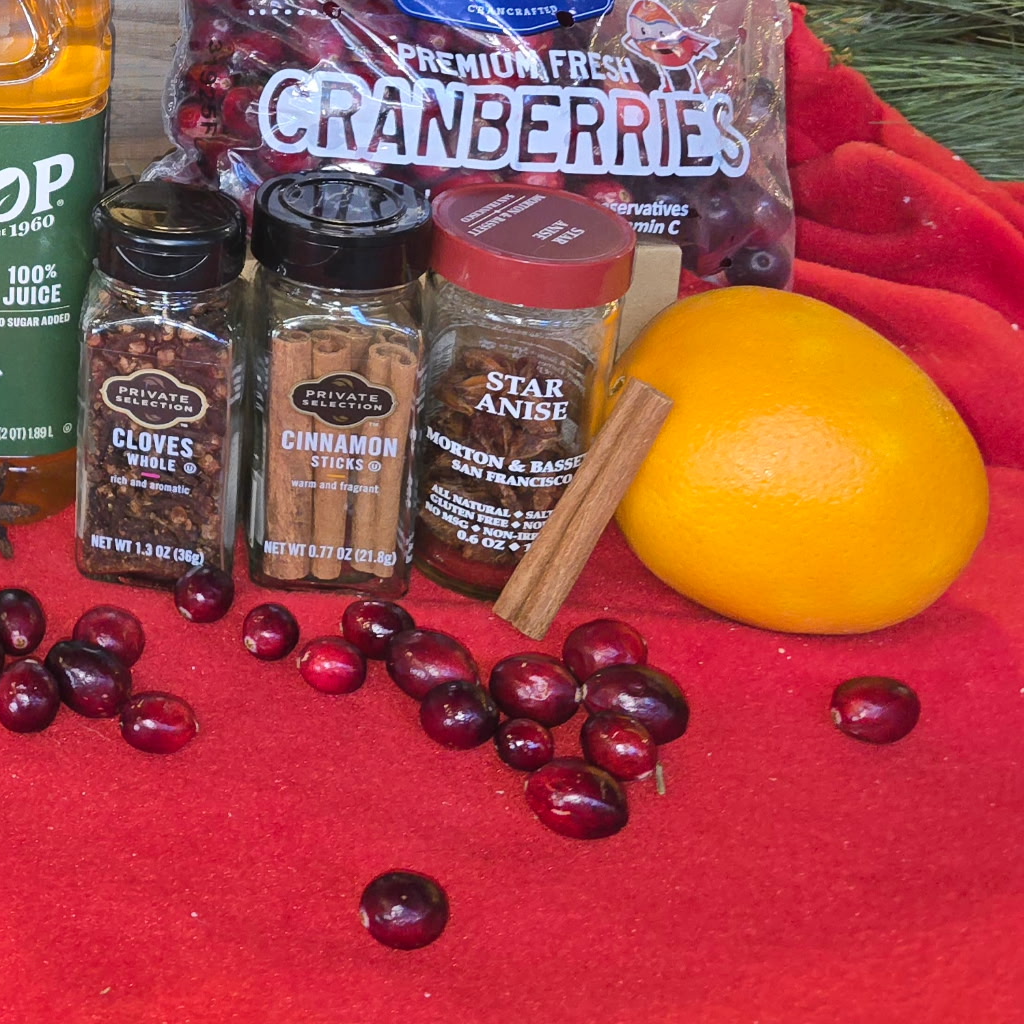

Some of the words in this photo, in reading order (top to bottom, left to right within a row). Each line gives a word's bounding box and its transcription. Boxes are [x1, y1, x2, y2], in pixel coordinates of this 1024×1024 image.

[467, 4, 558, 16] CRANCRAFTED
[397, 42, 538, 79] PREMIUM
[549, 50, 640, 83] FRESH
[262, 70, 748, 175] CRANBERRIES
[602, 200, 689, 216] servatives
[9, 214, 55, 237] 1960
[628, 219, 665, 234] min
[668, 220, 681, 235] C
[8, 264, 57, 284] 100%
[2, 284, 62, 306] JUICE
[7, 316, 39, 328] SUGAR
[41, 313, 70, 326] ADDED
[119, 386, 189, 404] PRIVATE
[305, 389, 379, 402] PRIVATE
[486, 371, 564, 398] STAR
[115, 396, 193, 413] SELECTION
[302, 399, 382, 411] SELECTION
[474, 393, 569, 421] ANISE
[9, 426, 26, 441] QT)
[48, 425, 54, 438] L
[112, 427, 193, 459] CLOVES
[281, 430, 398, 458] CINNAMON
[426, 426, 505, 470] MORTON
[508, 460, 526, 473] &
[530, 453, 587, 474] BASSE
[127, 452, 176, 472] WHOLE
[311, 455, 364, 471] STICKS
[110, 474, 128, 486] rich
[130, 479, 147, 489] and
[149, 482, 191, 494] aromatic
[451, 459, 483, 479] SAN
[486, 470, 573, 488] FRANCISCO
[291, 480, 316, 488] warm
[319, 481, 336, 490] and
[340, 481, 379, 494] fragrant
[429, 493, 475, 520] GLUTEN
[477, 513, 509, 528] FREE
[431, 484, 451, 500] ALL
[452, 494, 511, 518] NATURAL
[425, 501, 441, 516] NO
[441, 511, 469, 529] MSG
[91, 534, 112, 549] NET
[115, 538, 132, 553] WT
[135, 542, 153, 556] 1.3
[156, 545, 171, 559] OZ
[173, 548, 205, 566] (36g)
[457, 529, 479, 545] 0.6
[481, 538, 505, 551] OZ
[264, 540, 285, 554] NET
[288, 543, 306, 557] WT
[309, 544, 333, 559] 0.77
[336, 547, 352, 561] OZ
[354, 549, 397, 566] (21.8g)
